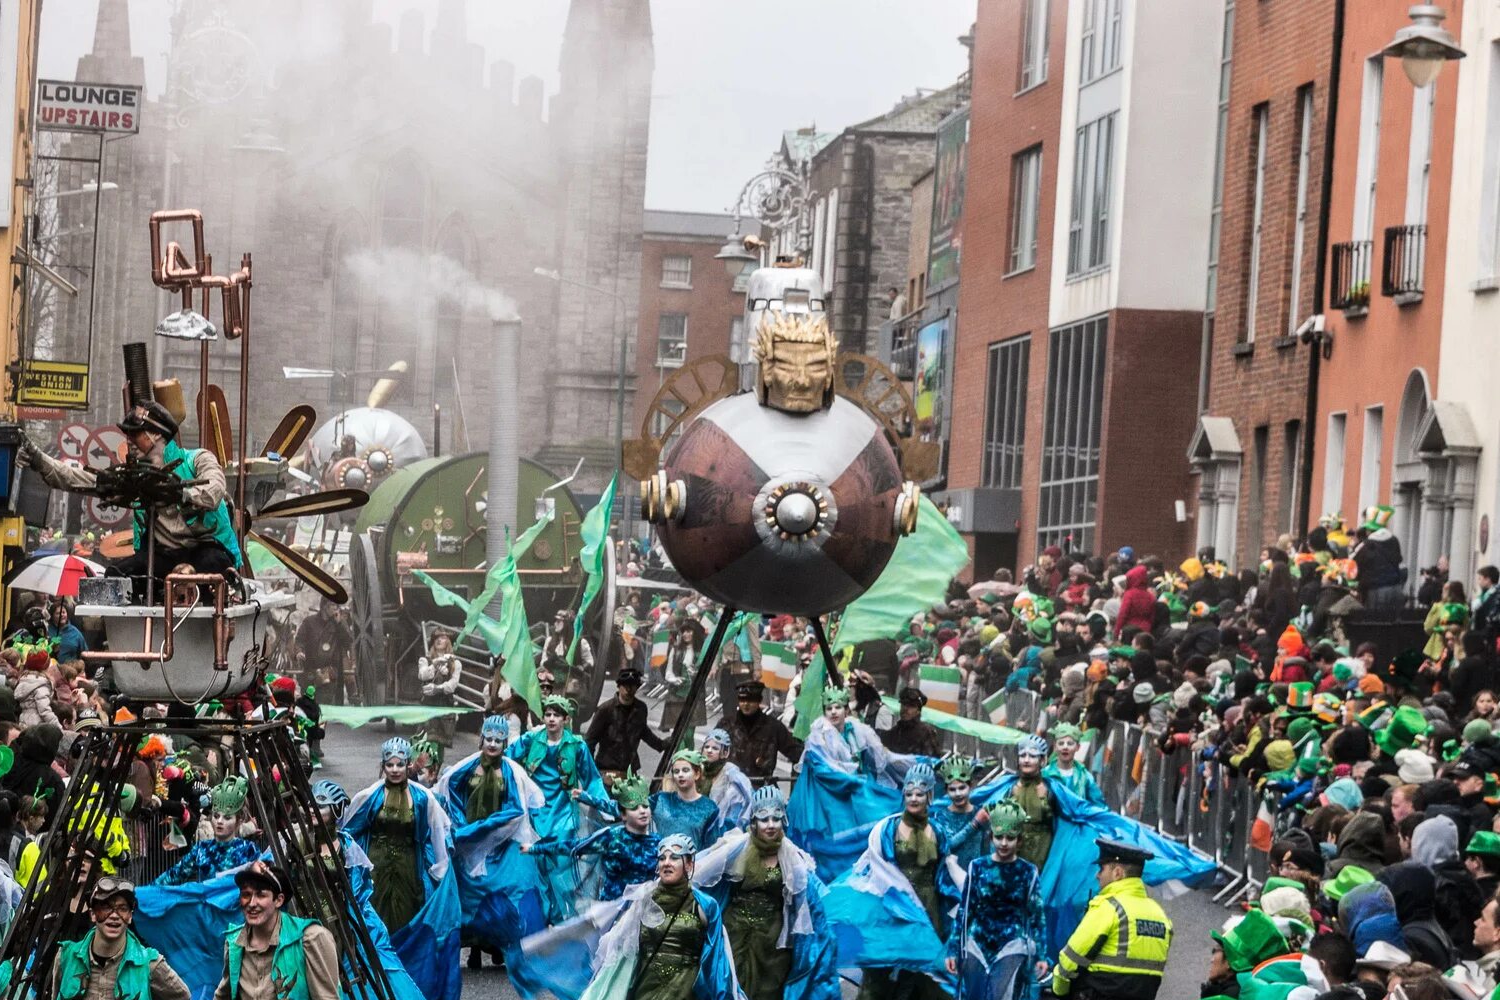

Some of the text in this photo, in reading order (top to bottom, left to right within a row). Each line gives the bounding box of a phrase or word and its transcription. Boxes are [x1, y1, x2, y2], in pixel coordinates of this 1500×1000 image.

[42, 85, 136, 107] LOUNGE
[41, 107, 133, 129] UPSTAIRS
[40, 381, 72, 389] UNION
